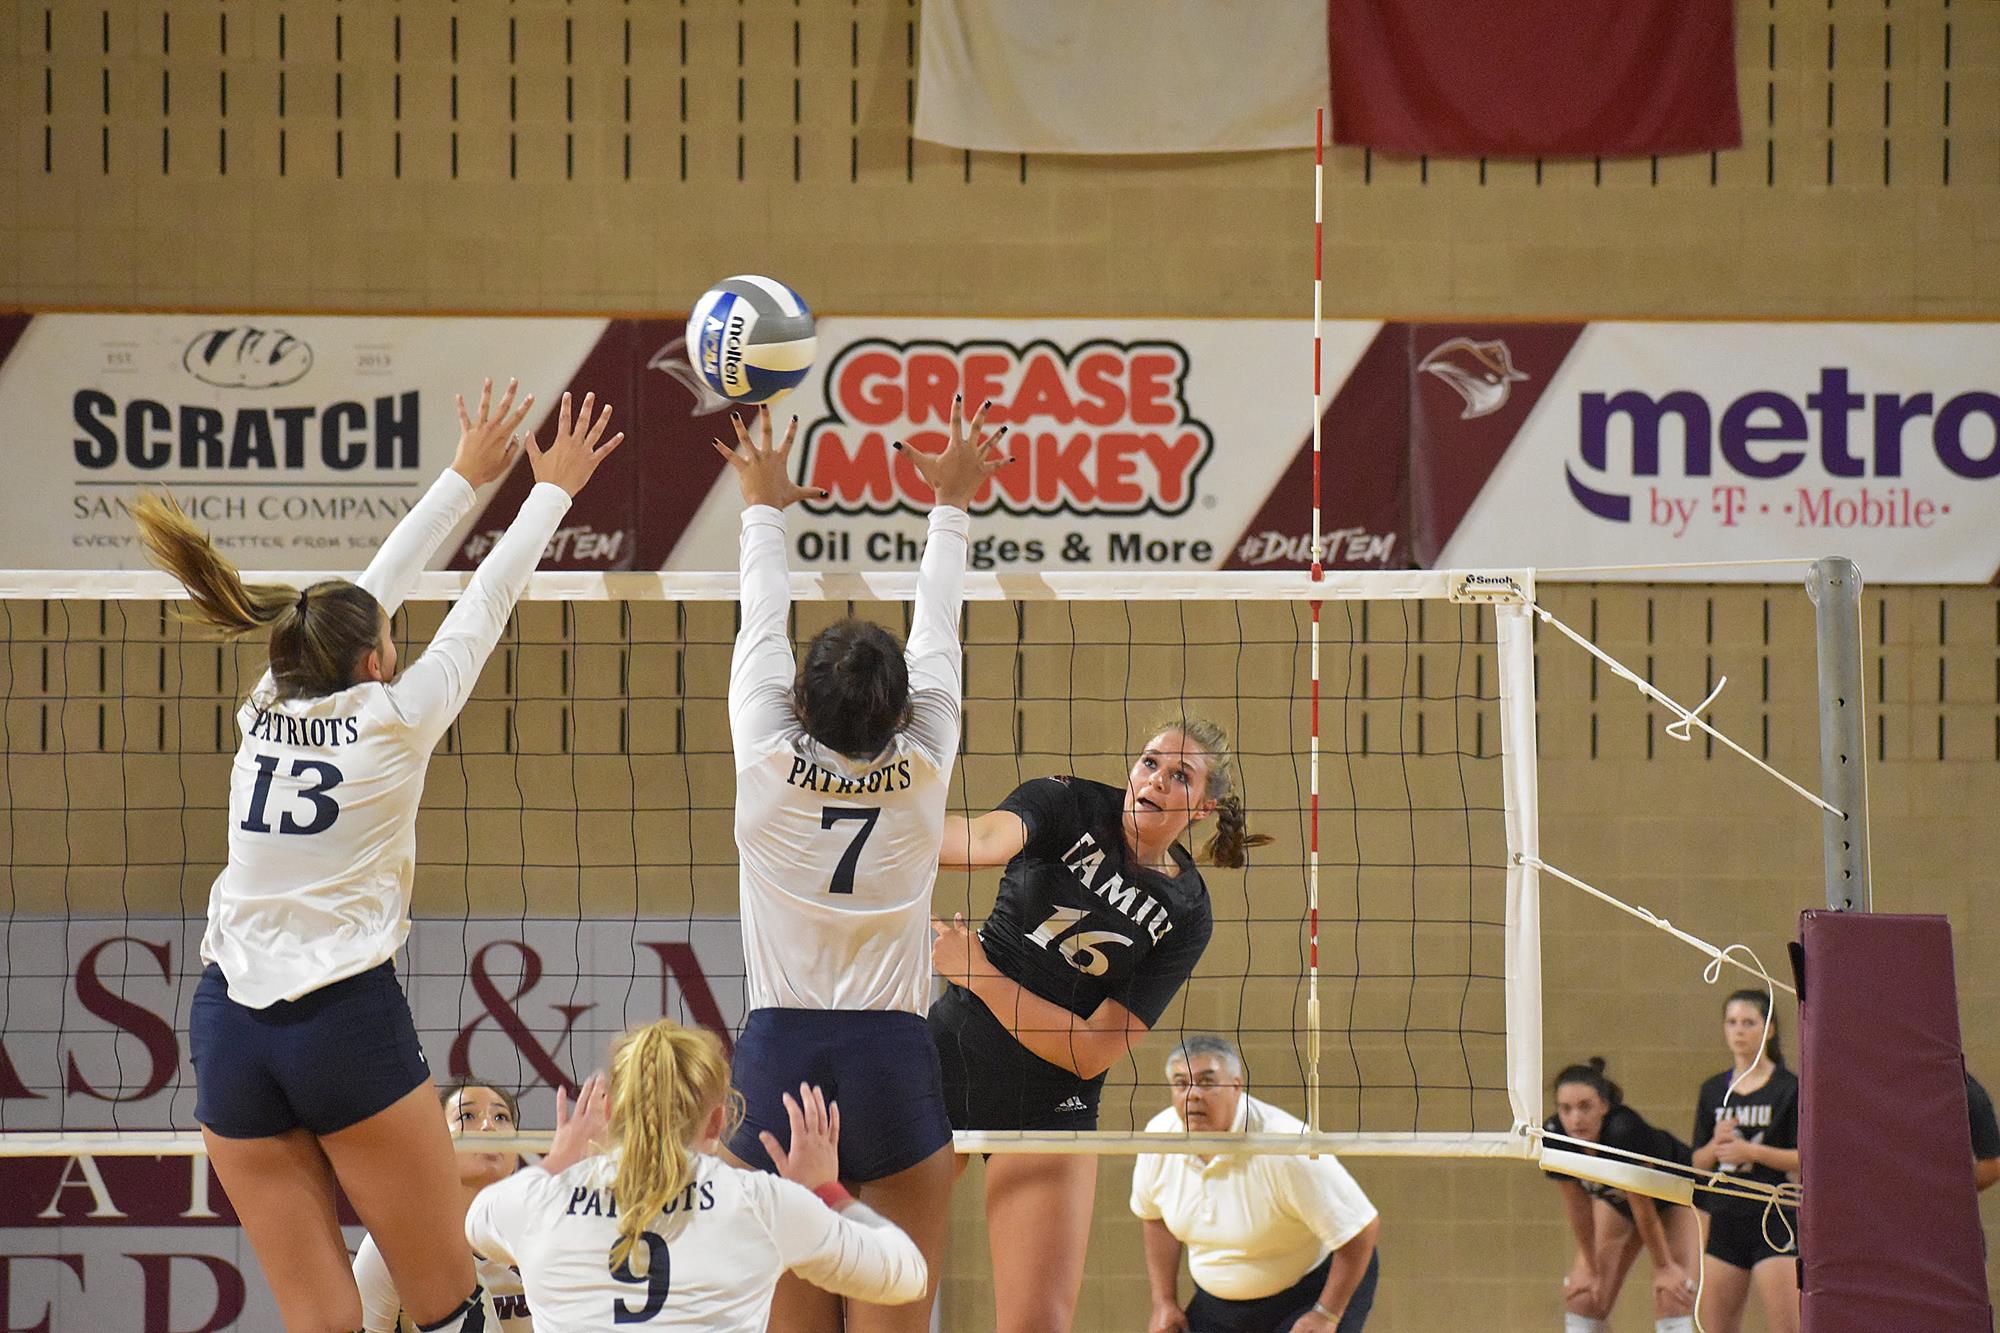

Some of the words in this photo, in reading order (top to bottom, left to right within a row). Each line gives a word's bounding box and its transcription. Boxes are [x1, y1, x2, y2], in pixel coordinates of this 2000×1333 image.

[725, 315, 745, 385] molten
[838, 351, 1178, 426] GREASE
[1577, 367, 2000, 479] metro
[73, 389, 421, 470] SCRATCH
[809, 430, 1201, 504] MONKEY
[1649, 487, 1698, 538] by
[797, 531, 850, 562] Oil
[866, 531, 1045, 570] Chges
[1061, 532, 1091, 562] &
[1109, 533, 1212, 562] More
[1476, 576, 1512, 584] Senoh
[248, 709, 358, 747] PATRIOTS
[240, 753, 344, 835] 13
[787, 756, 911, 794] PATRIOTS
[821, 805, 881, 894] 7
[1060, 832, 1173, 947] TAMIU
[1024, 904, 1134, 976] 16
[608, 1231, 671, 1325] 9
